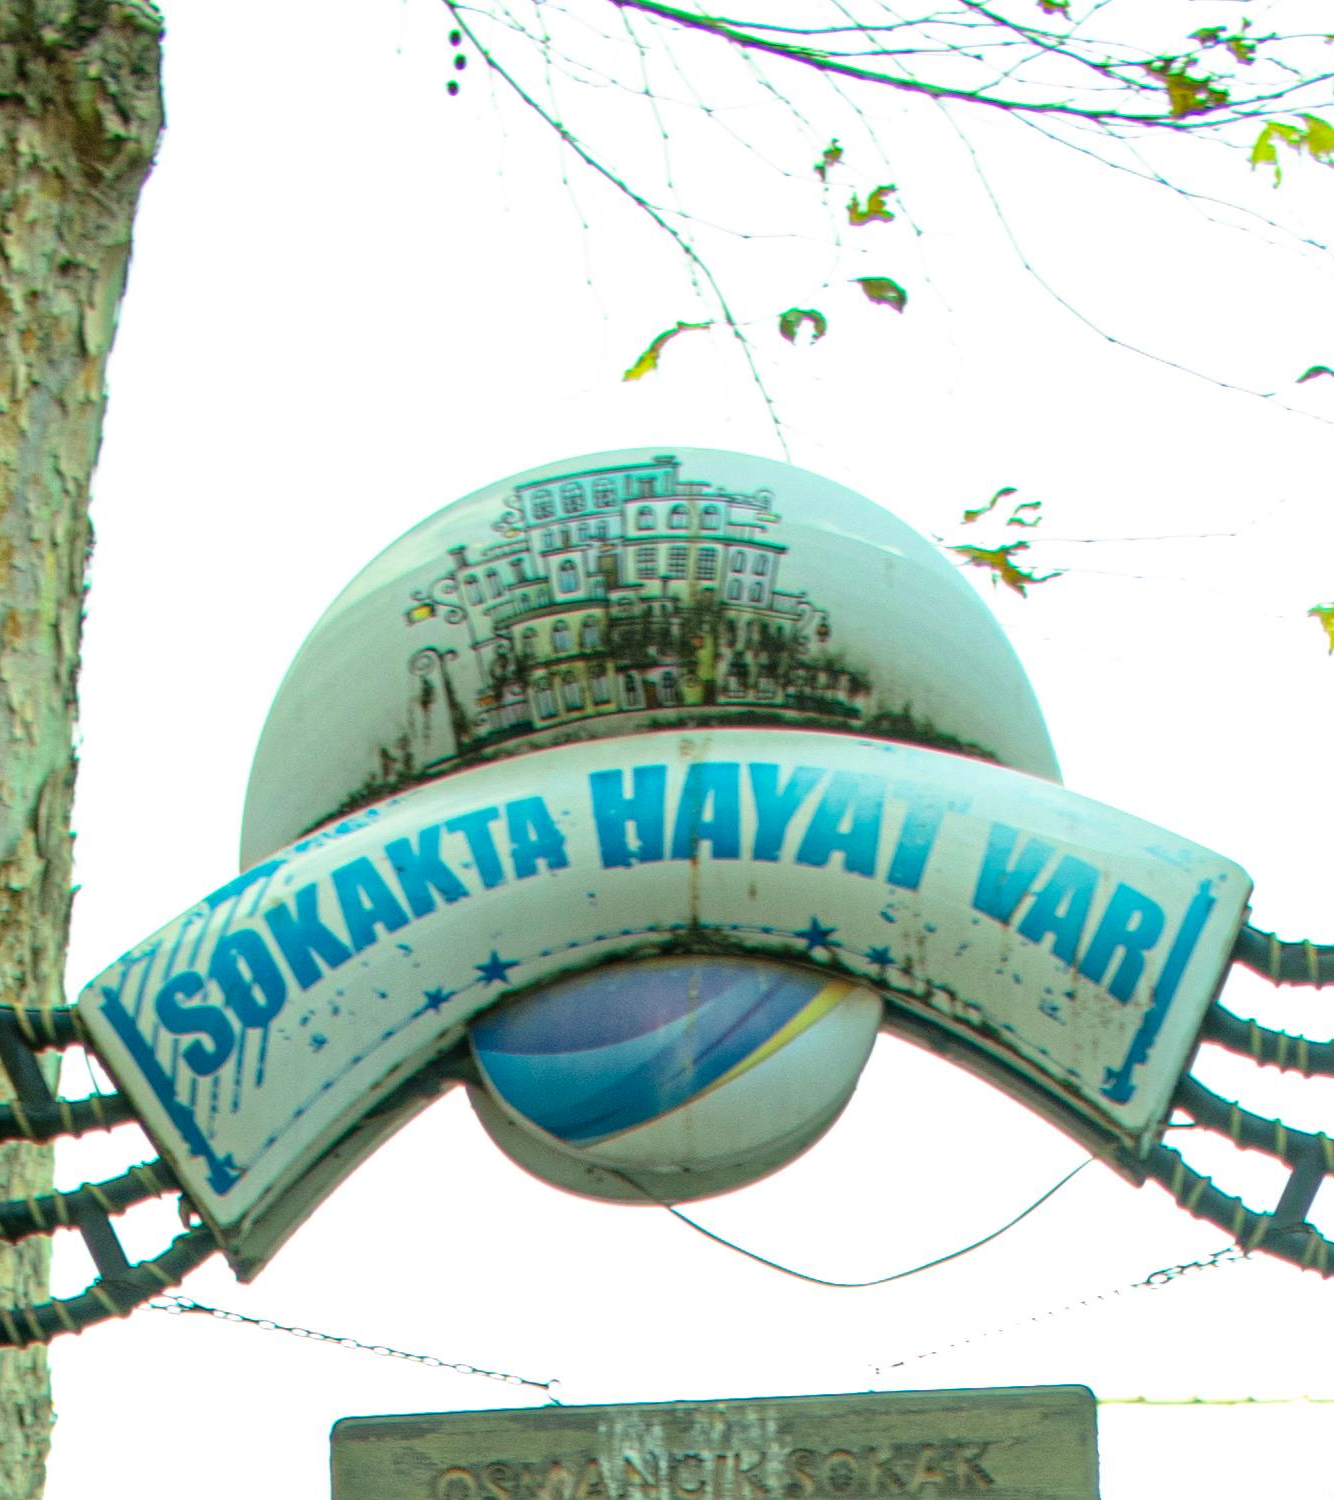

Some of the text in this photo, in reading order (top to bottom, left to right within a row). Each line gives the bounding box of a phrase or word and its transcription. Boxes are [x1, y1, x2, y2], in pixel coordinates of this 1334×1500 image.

[154, 760, 1166, 1078] SOKAKTA HAYAT VAR
[787, 1442, 997, 1500] SOKAK
